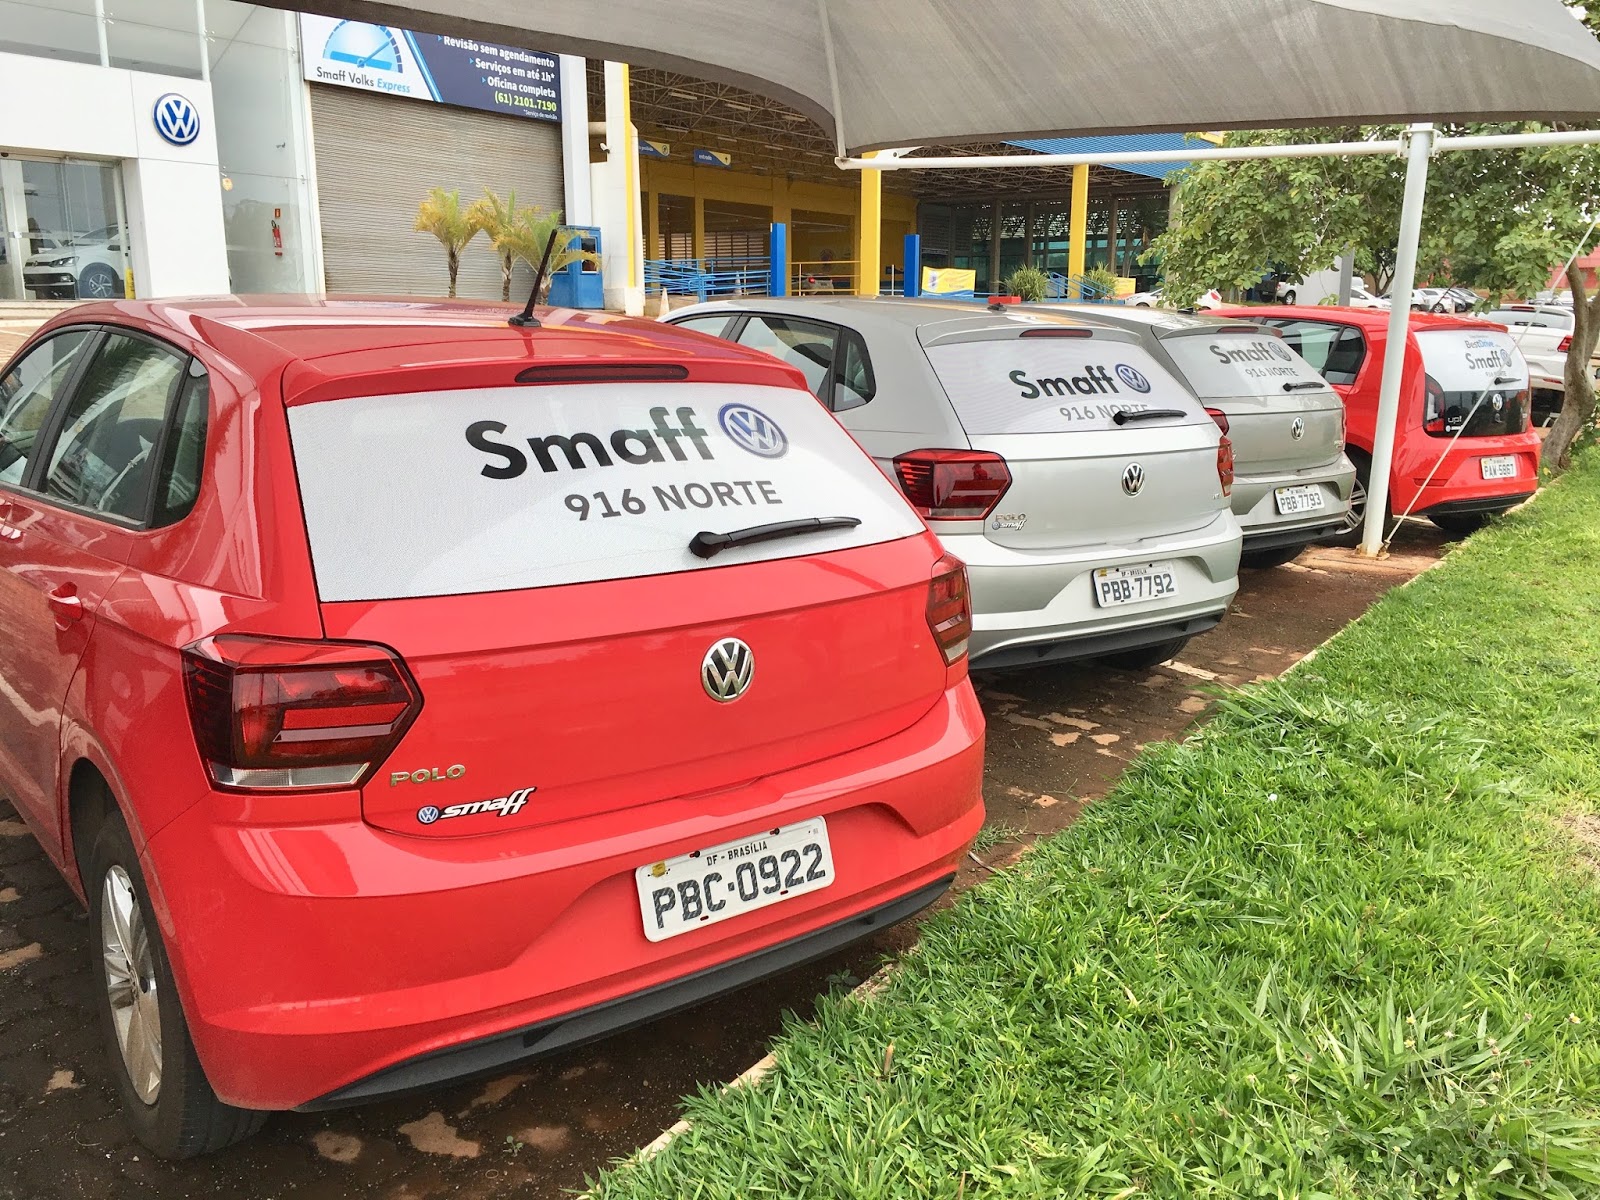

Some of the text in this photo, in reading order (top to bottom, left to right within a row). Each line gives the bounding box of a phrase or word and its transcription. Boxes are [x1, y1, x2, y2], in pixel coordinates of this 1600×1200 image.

[443, 35, 555, 68] Revisão sem agendamento
[316, 66, 411, 94] Smaff Volks Express
[475, 58, 512, 76] Serviços
[512, 65, 526, 76] em
[526, 66, 541, 80] até
[487, 76, 556, 99] Oficina completa
[494, 91, 557, 113] (61) 2101.7190
[1208, 341, 1275, 365] Smaff
[1464, 350, 1502, 370] Smaff
[1008, 364, 1120, 399] Smaff
[1245, 367, 1299, 379] 916 NORTE
[1059, 405, 1096, 422] 916
[1447, 415, 1462, 424] up!
[464, 405, 715, 480] Smaff
[564, 479, 784, 521] 916 NORTE
[389, 763, 467, 788] POLO
[440, 786, 538, 817] smaff
[706, 854, 718, 866] DF
[727, 840, 768, 860] BRASÍLIA
